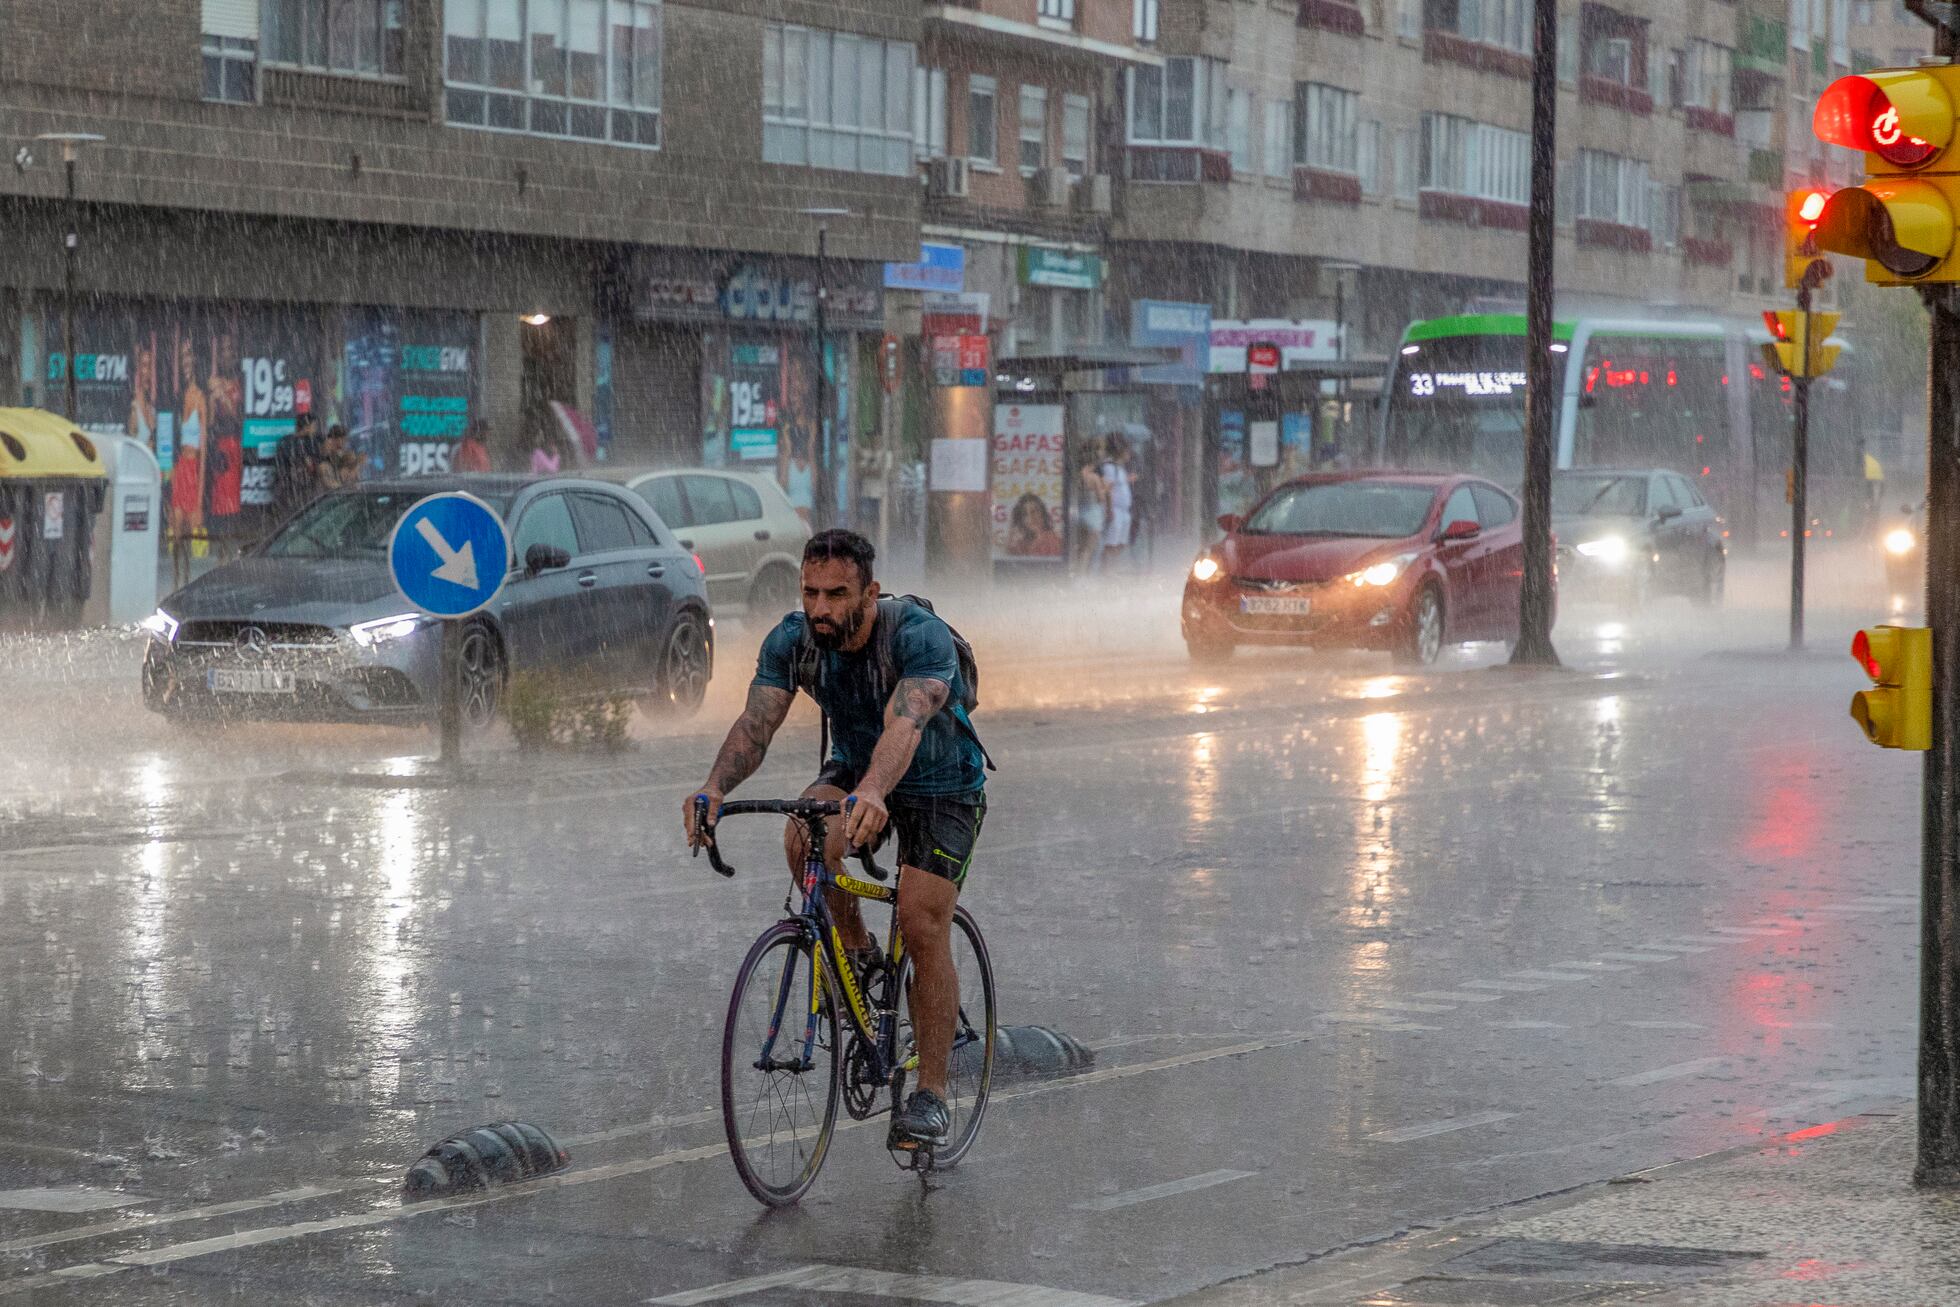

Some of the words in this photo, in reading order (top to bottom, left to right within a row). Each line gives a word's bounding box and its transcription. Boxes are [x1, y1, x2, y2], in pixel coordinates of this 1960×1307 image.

[1410, 373, 1434, 396] 33
[994, 434, 1064, 452] GAFAS
[995, 457, 1064, 475] GAFAS
